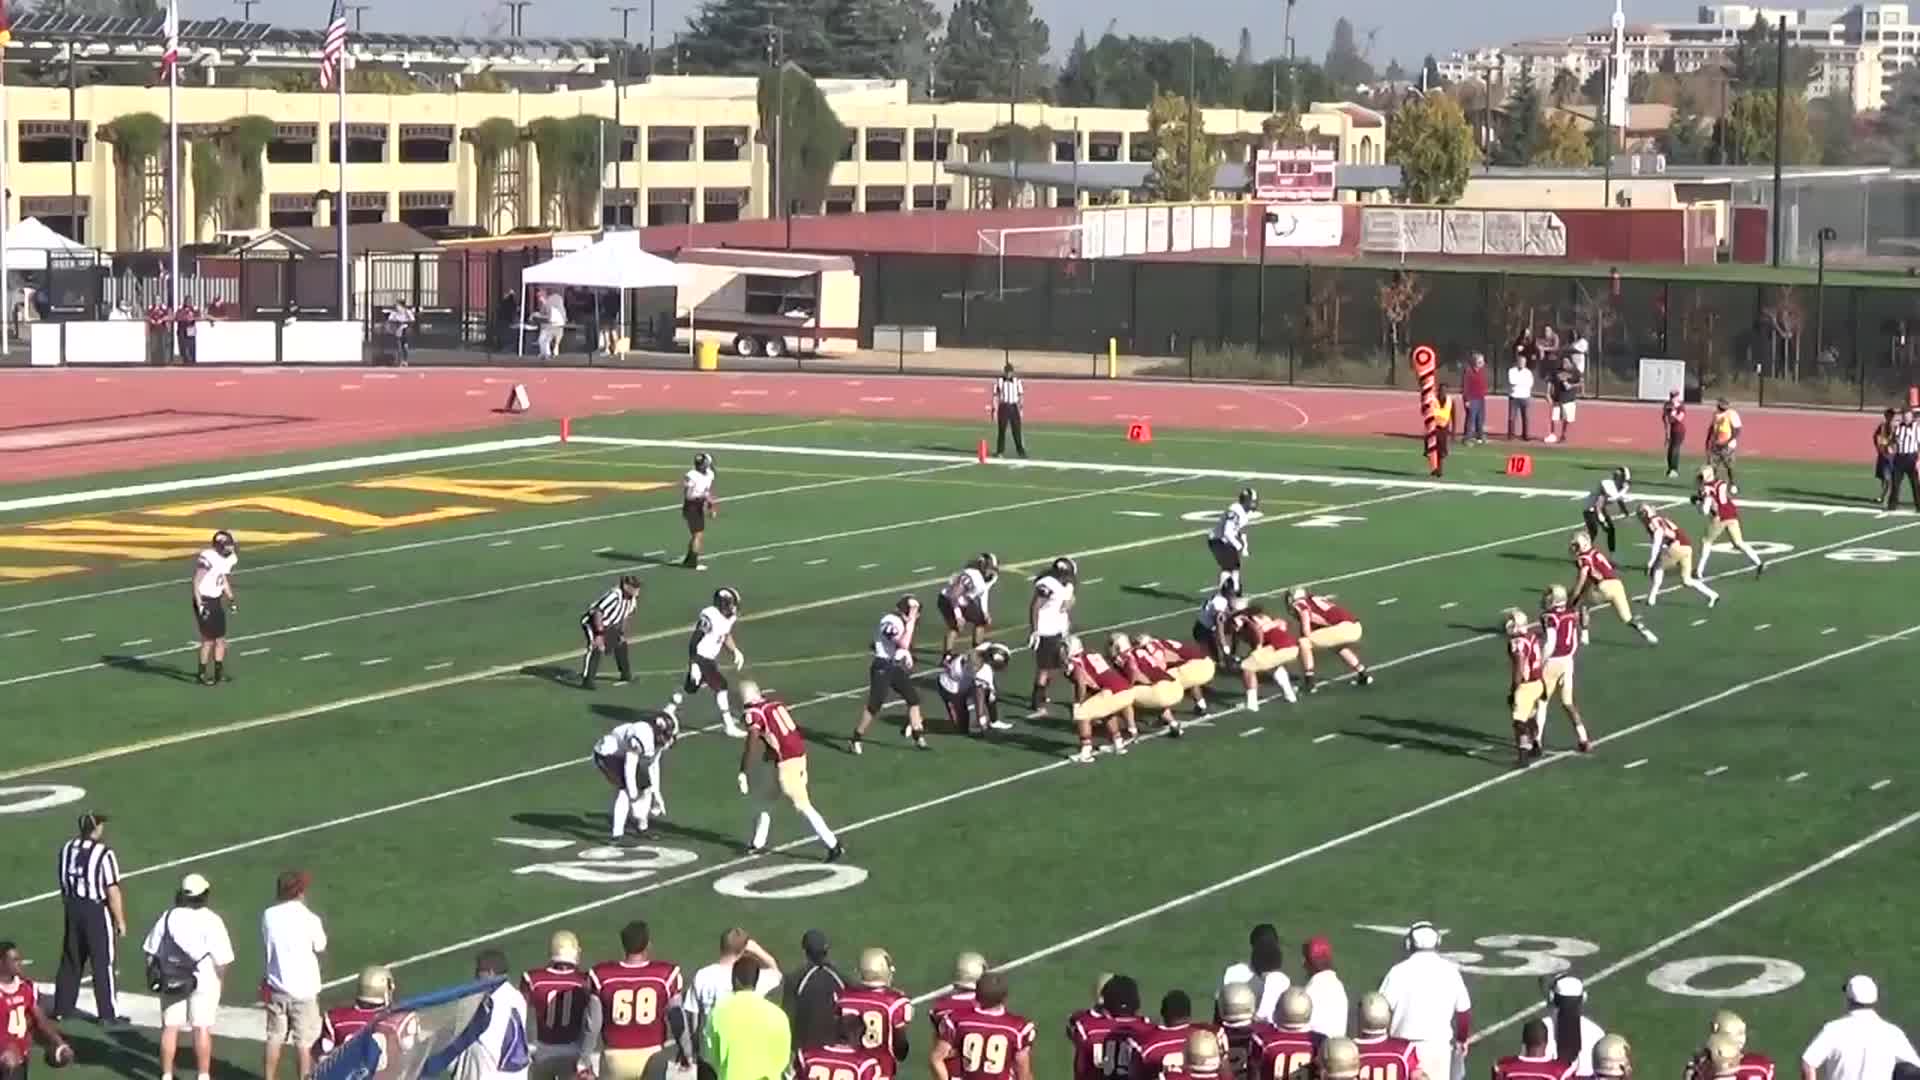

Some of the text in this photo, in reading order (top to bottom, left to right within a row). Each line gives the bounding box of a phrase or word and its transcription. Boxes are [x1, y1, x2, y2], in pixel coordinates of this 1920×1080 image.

[1130, 425, 1142, 440] G
[1511, 457, 1525, 473] 10
[612, 987, 657, 1026] 68
[962, 1033, 1008, 1073] 99
